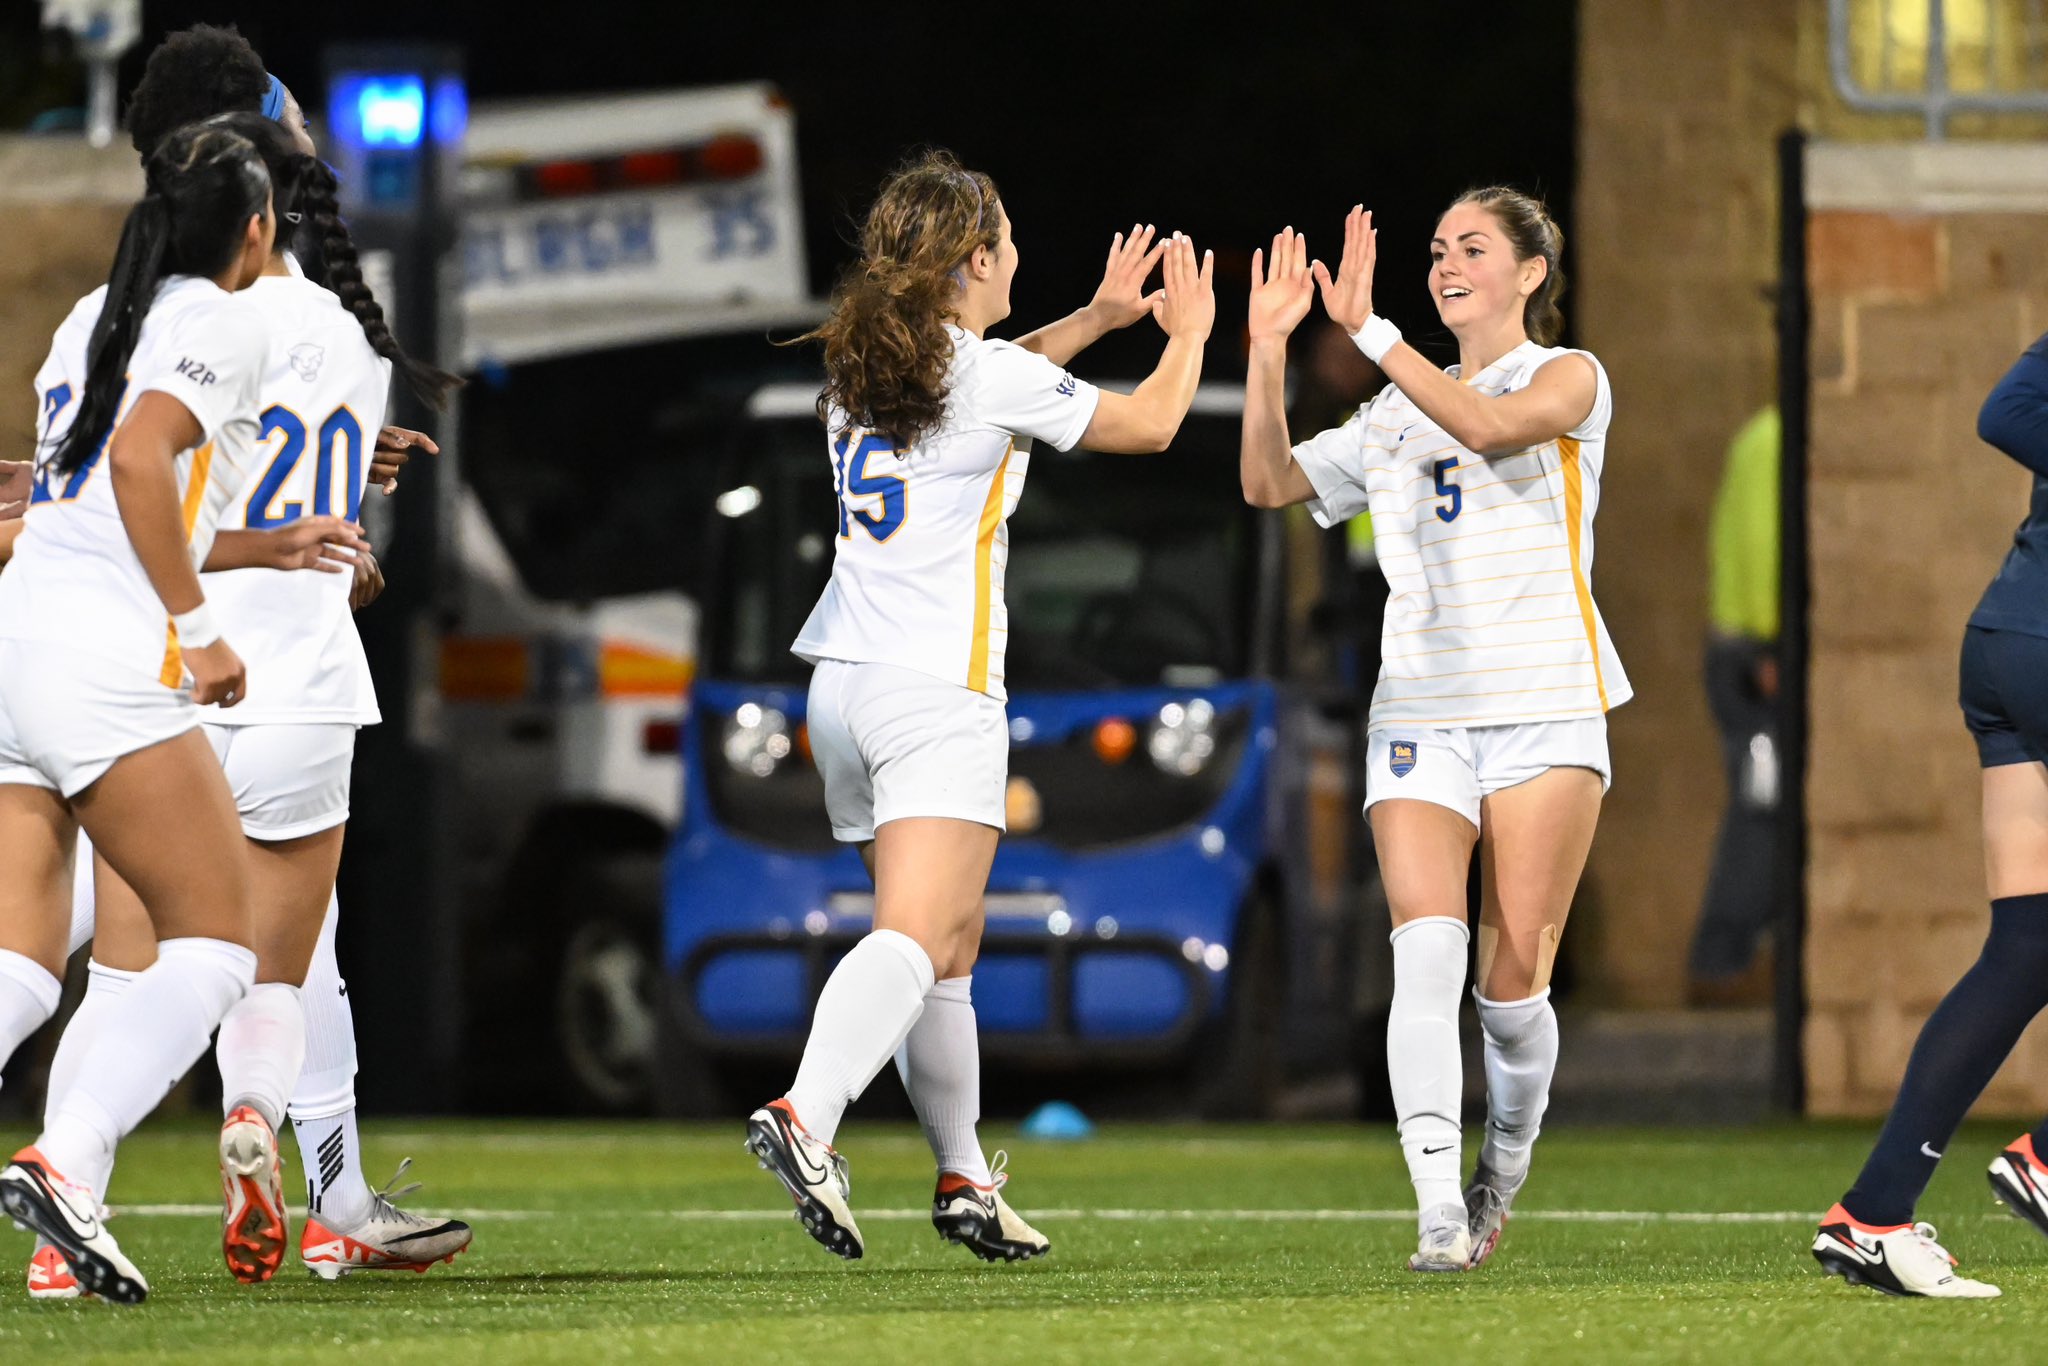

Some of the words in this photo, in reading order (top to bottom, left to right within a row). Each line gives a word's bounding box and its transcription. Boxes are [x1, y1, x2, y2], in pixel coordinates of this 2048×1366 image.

[175, 357, 217, 386] H2P
[1056, 374, 1075, 397] H2
[243, 402, 364, 530] 20
[834, 429, 908, 542] 15
[1434, 455, 1462, 523] 5
